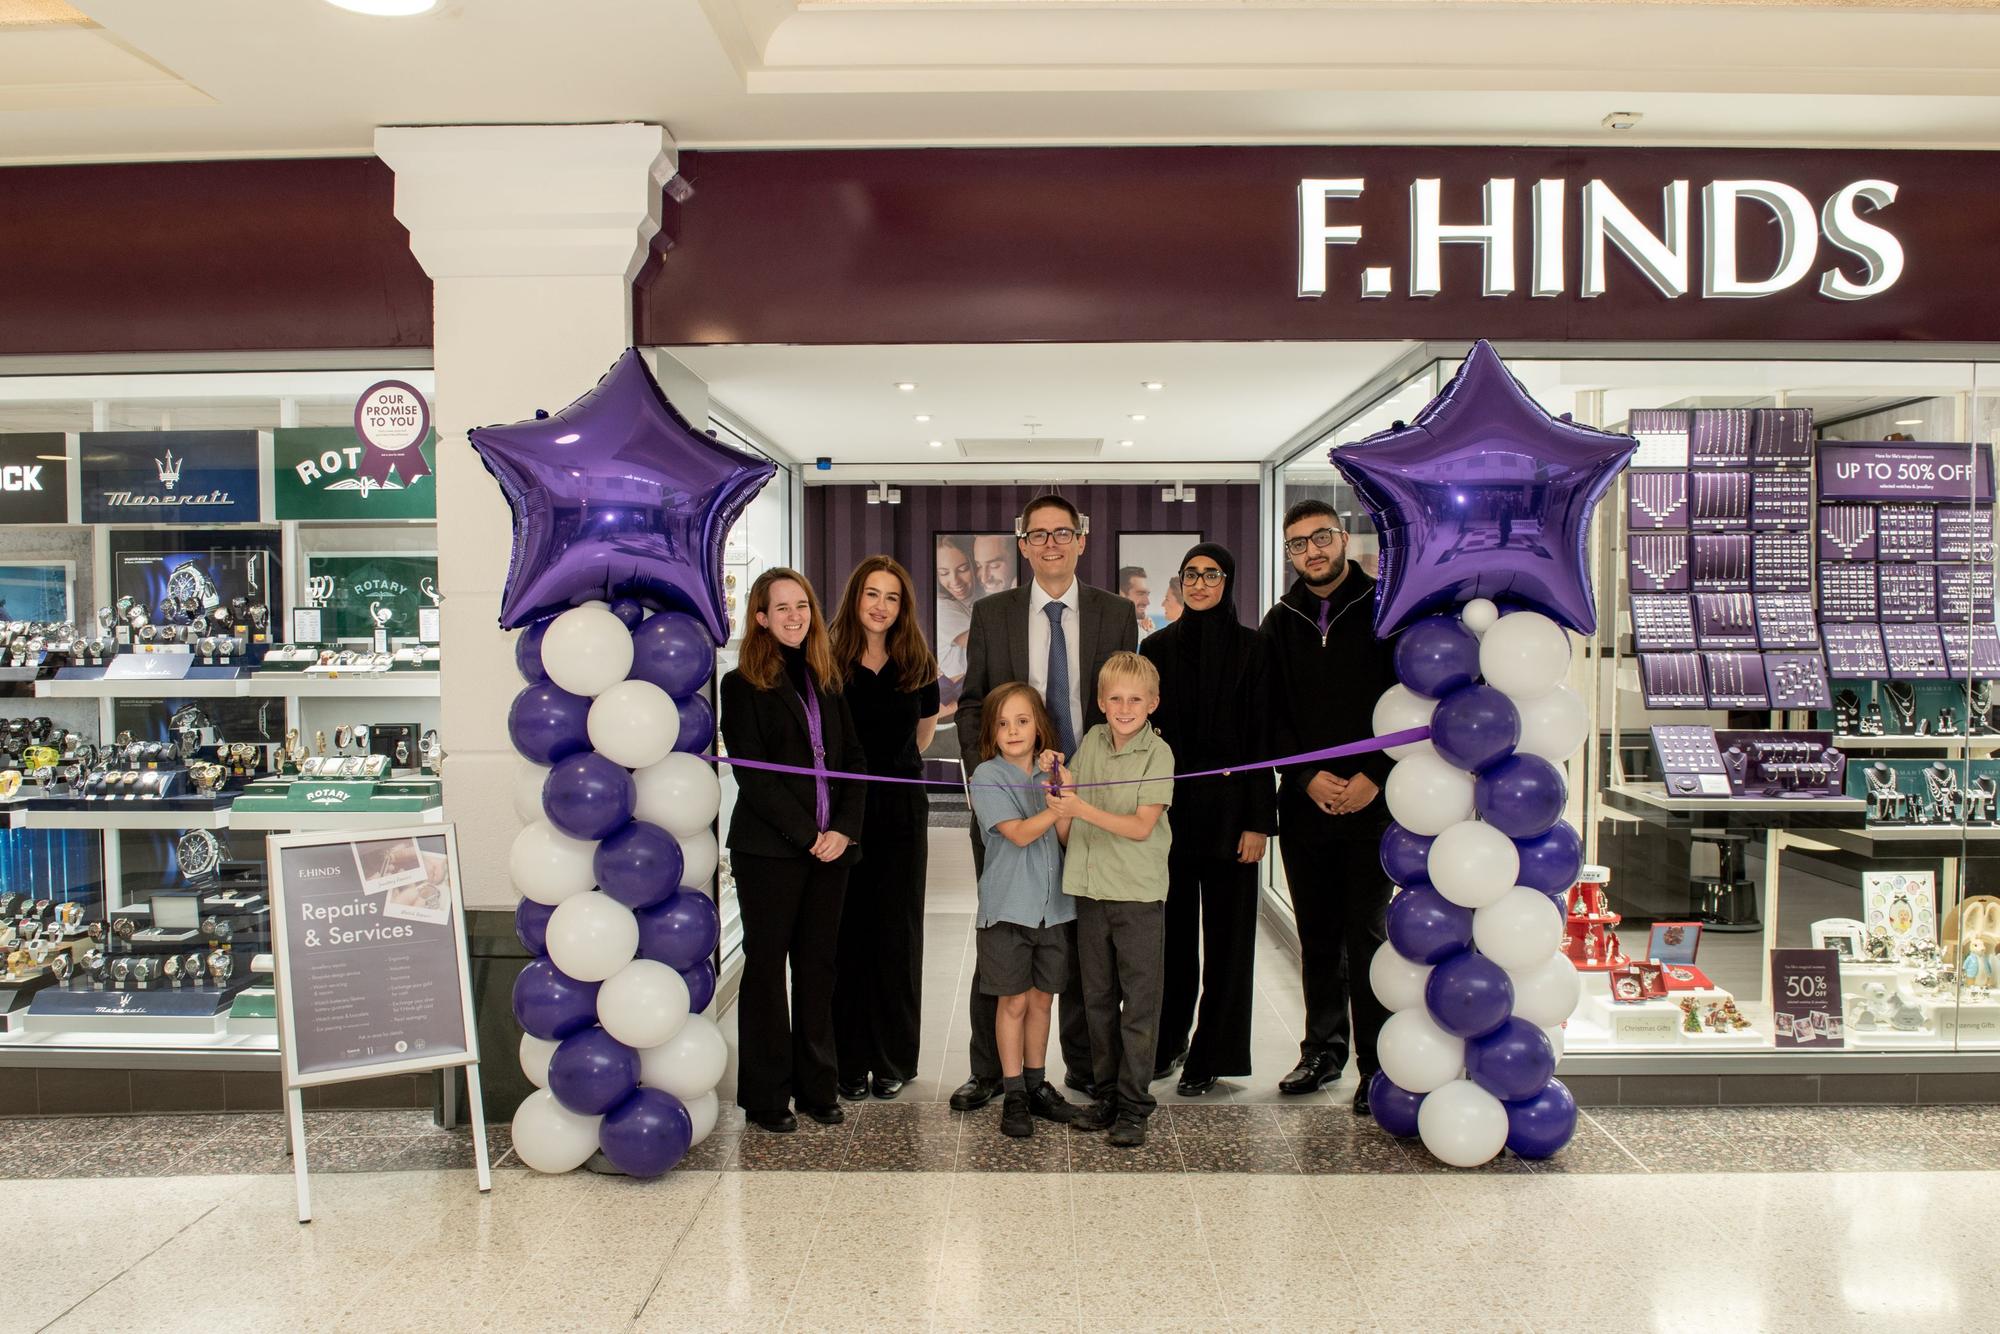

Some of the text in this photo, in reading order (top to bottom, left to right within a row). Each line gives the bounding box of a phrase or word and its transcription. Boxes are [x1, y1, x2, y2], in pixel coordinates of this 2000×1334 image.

[1298, 178, 1904, 300] F.HINDS
[379, 395, 404, 404] OUR
[366, 406, 417, 416] PROMISE
[370, 417, 415, 427] TO YOU
[0, 465, 43, 491] CK
[1836, 462, 1973, 481] UP TO 50% OFF
[103, 490, 235, 506] Maserati
[354, 579, 408, 595] ROTARY
[306, 788, 351, 800] ROTARY
[299, 866, 341, 878] F.HINDS
[302, 898, 378, 923] Repairs
[304, 923, 414, 947] & Services
[1786, 976, 1827, 997] 50%
